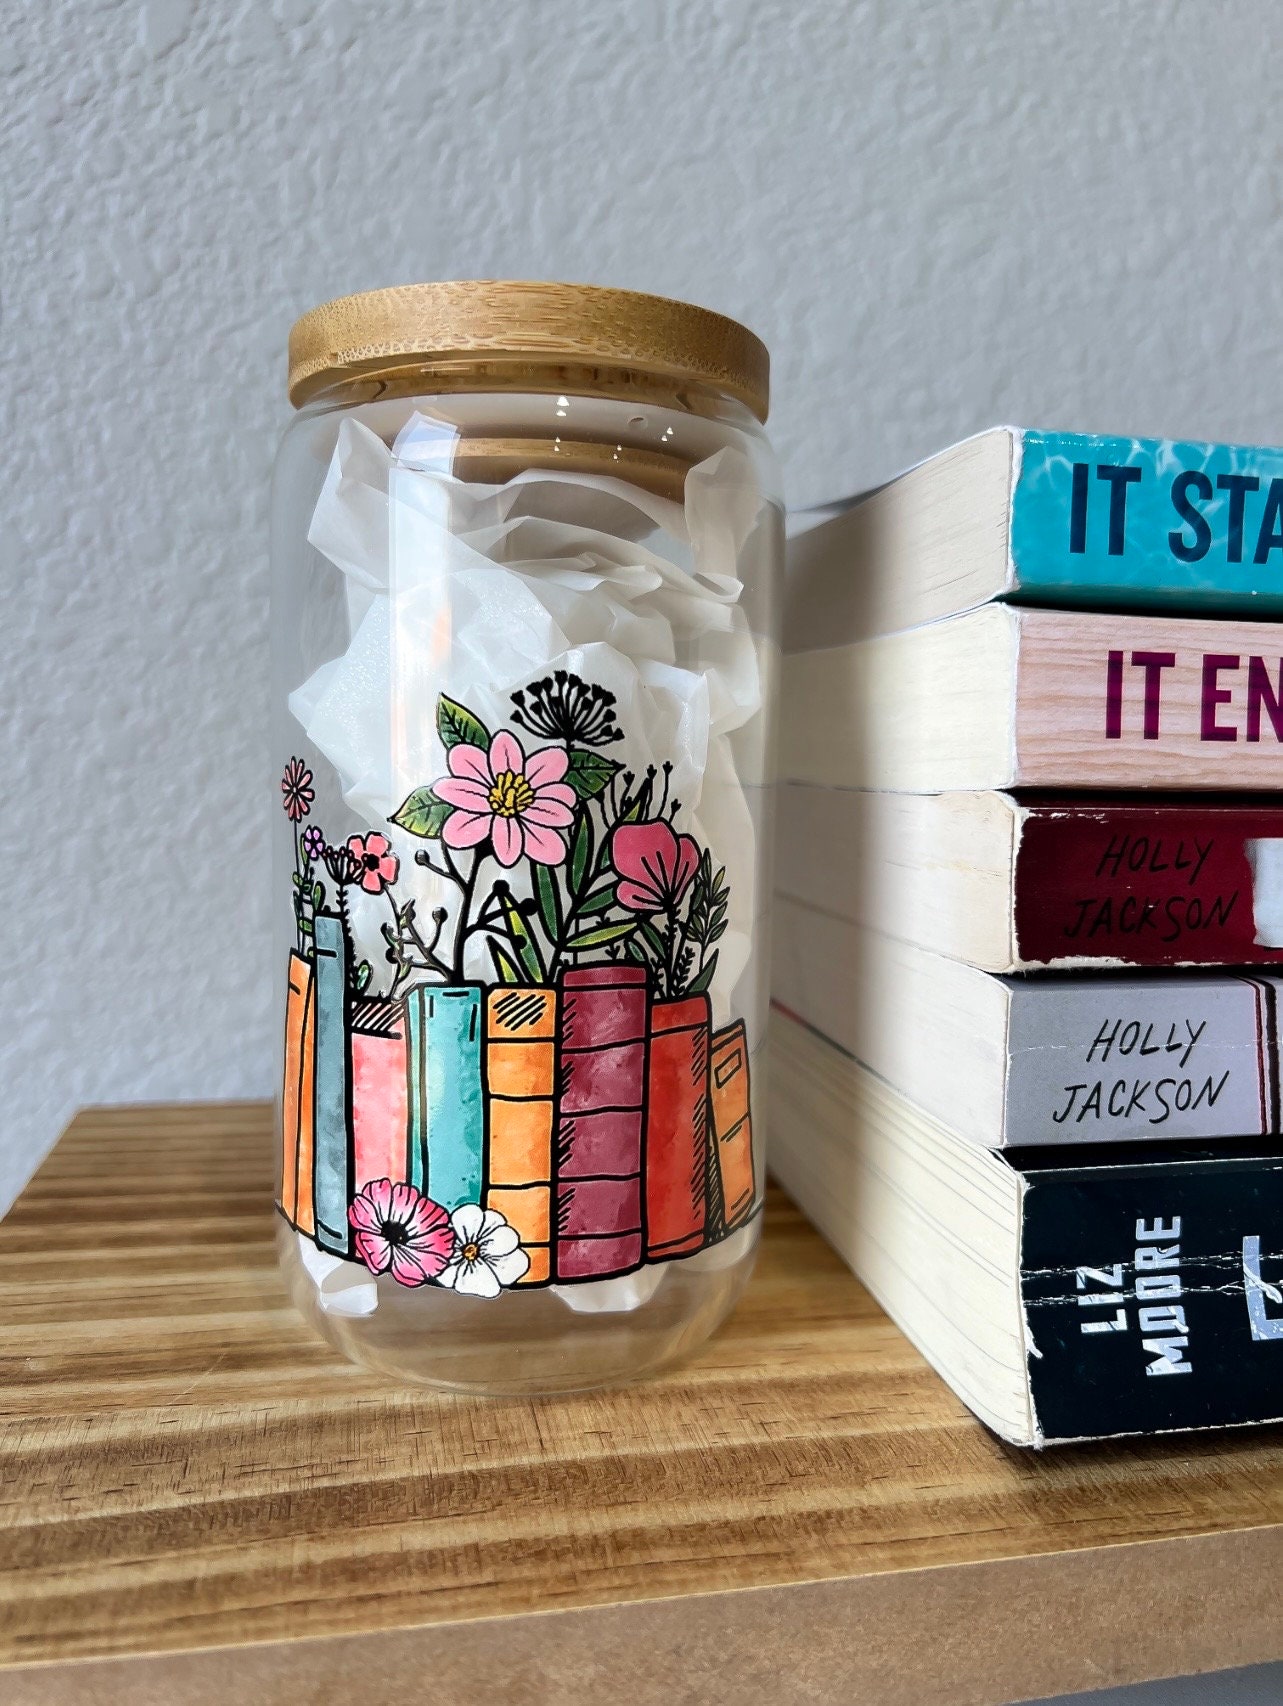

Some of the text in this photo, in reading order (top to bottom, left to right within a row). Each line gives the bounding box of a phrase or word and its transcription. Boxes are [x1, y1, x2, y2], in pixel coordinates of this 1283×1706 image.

[1070, 463, 1142, 556] IT
[1106, 650, 1176, 740] IT
[1096, 834, 1214, 886] HOLLY
[1064, 890, 1240, 942] JACKSON
[1086, 1019, 1206, 1068] HOLLY
[1053, 1070, 1230, 1124] JACKSON
[1076, 1264, 1128, 1334] LIZ
[1135, 1216, 1193, 1376] MOORE
